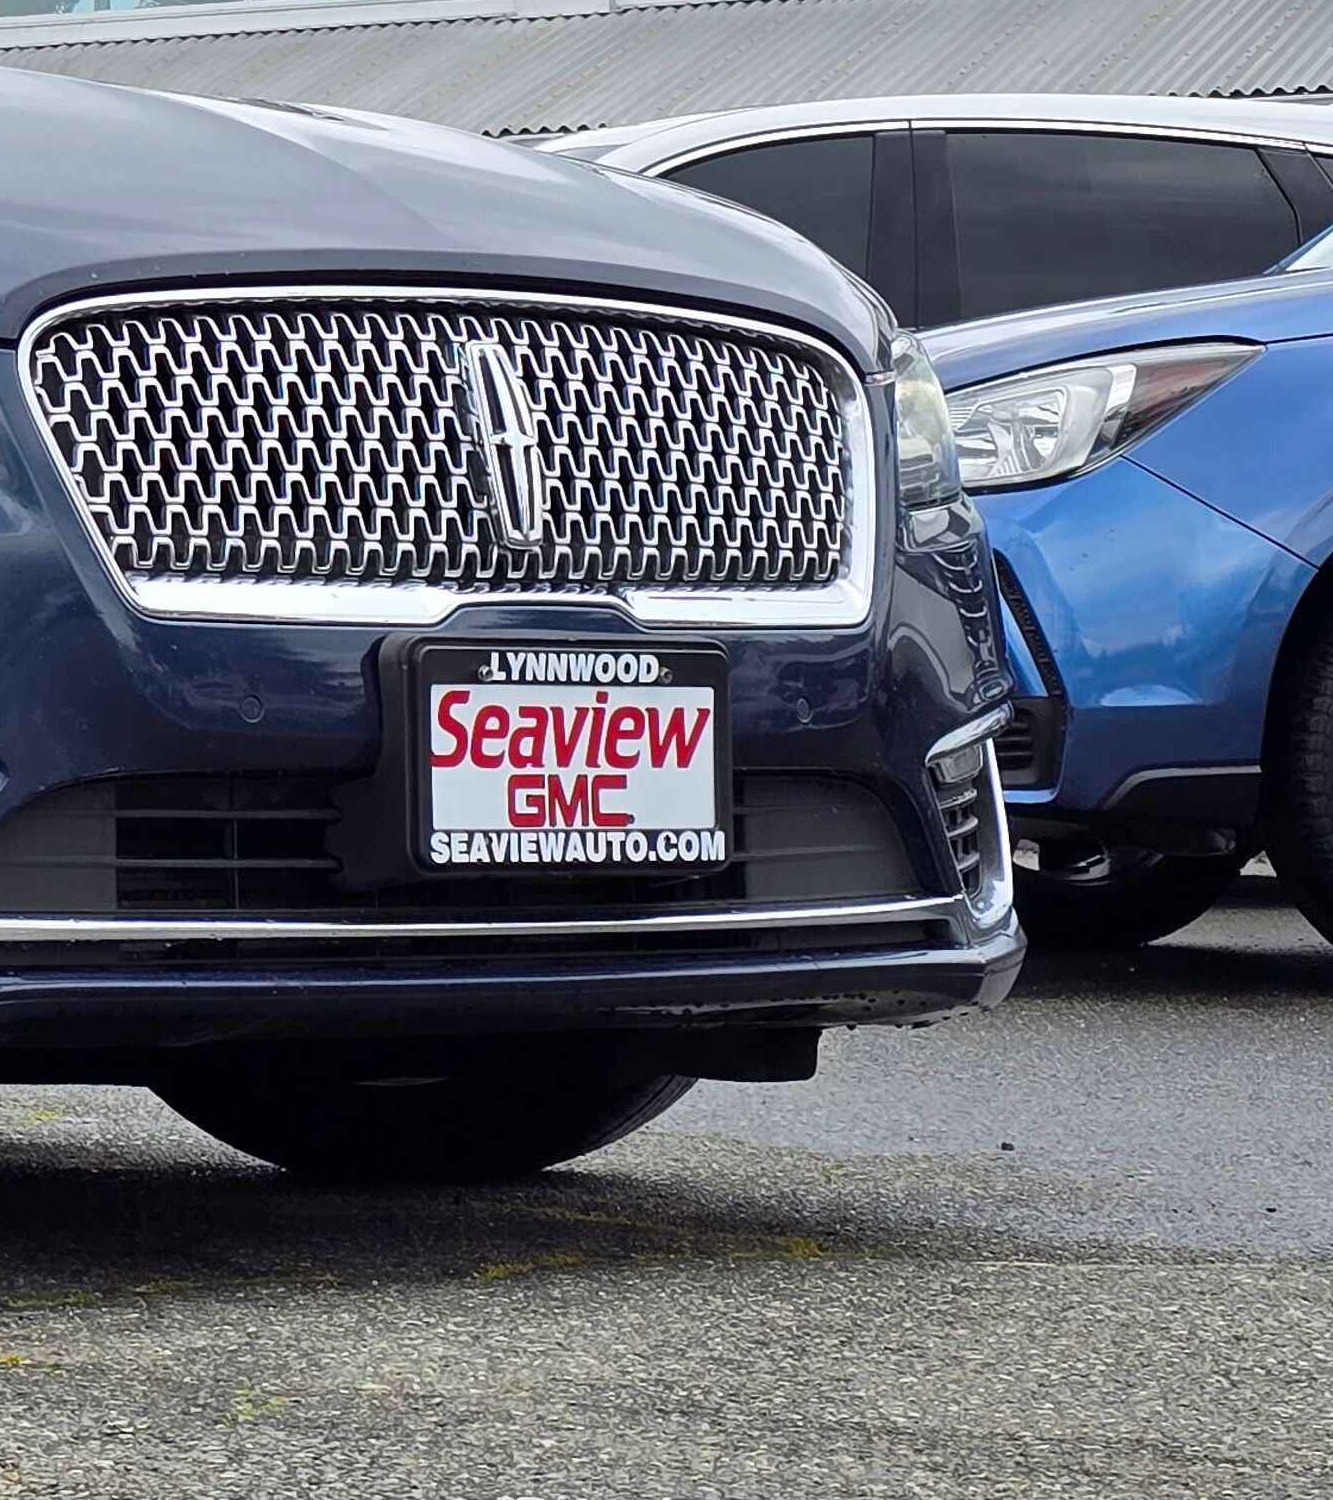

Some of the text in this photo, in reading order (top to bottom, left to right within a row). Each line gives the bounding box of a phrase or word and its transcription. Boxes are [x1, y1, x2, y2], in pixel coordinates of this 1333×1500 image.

[489, 651, 659, 683] LYNNWOOD
[430, 690, 712, 769] Seaview
[507, 773, 633, 828] GMC
[430, 830, 726, 864] SEAVIEWAUTO.COM
